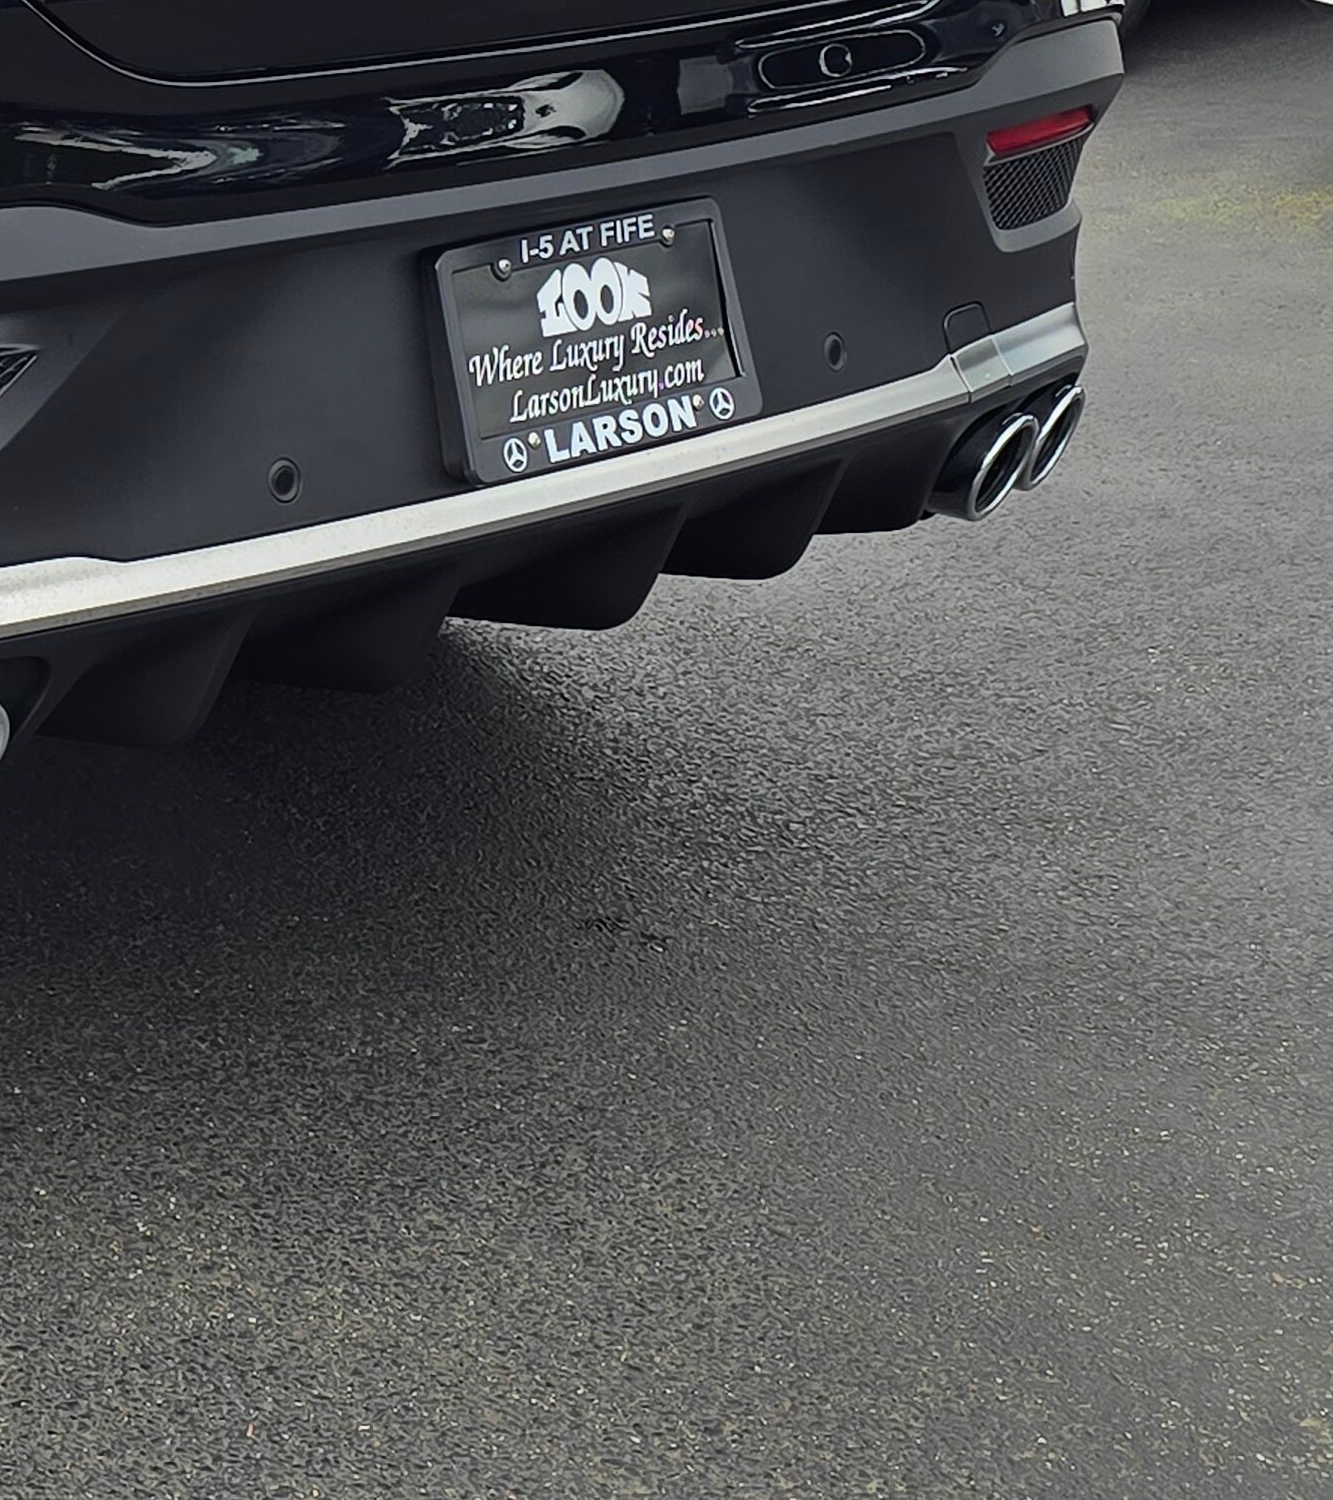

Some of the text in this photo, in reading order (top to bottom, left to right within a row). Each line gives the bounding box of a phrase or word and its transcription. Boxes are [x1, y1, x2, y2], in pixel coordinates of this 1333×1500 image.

[520, 214, 656, 264] I-5 AT FIFE
[468, 343, 544, 388] Where
[549, 334, 626, 371] Luxury
[509, 355, 705, 424] LarsonLuxury.com
[543, 394, 699, 464] LARSON
